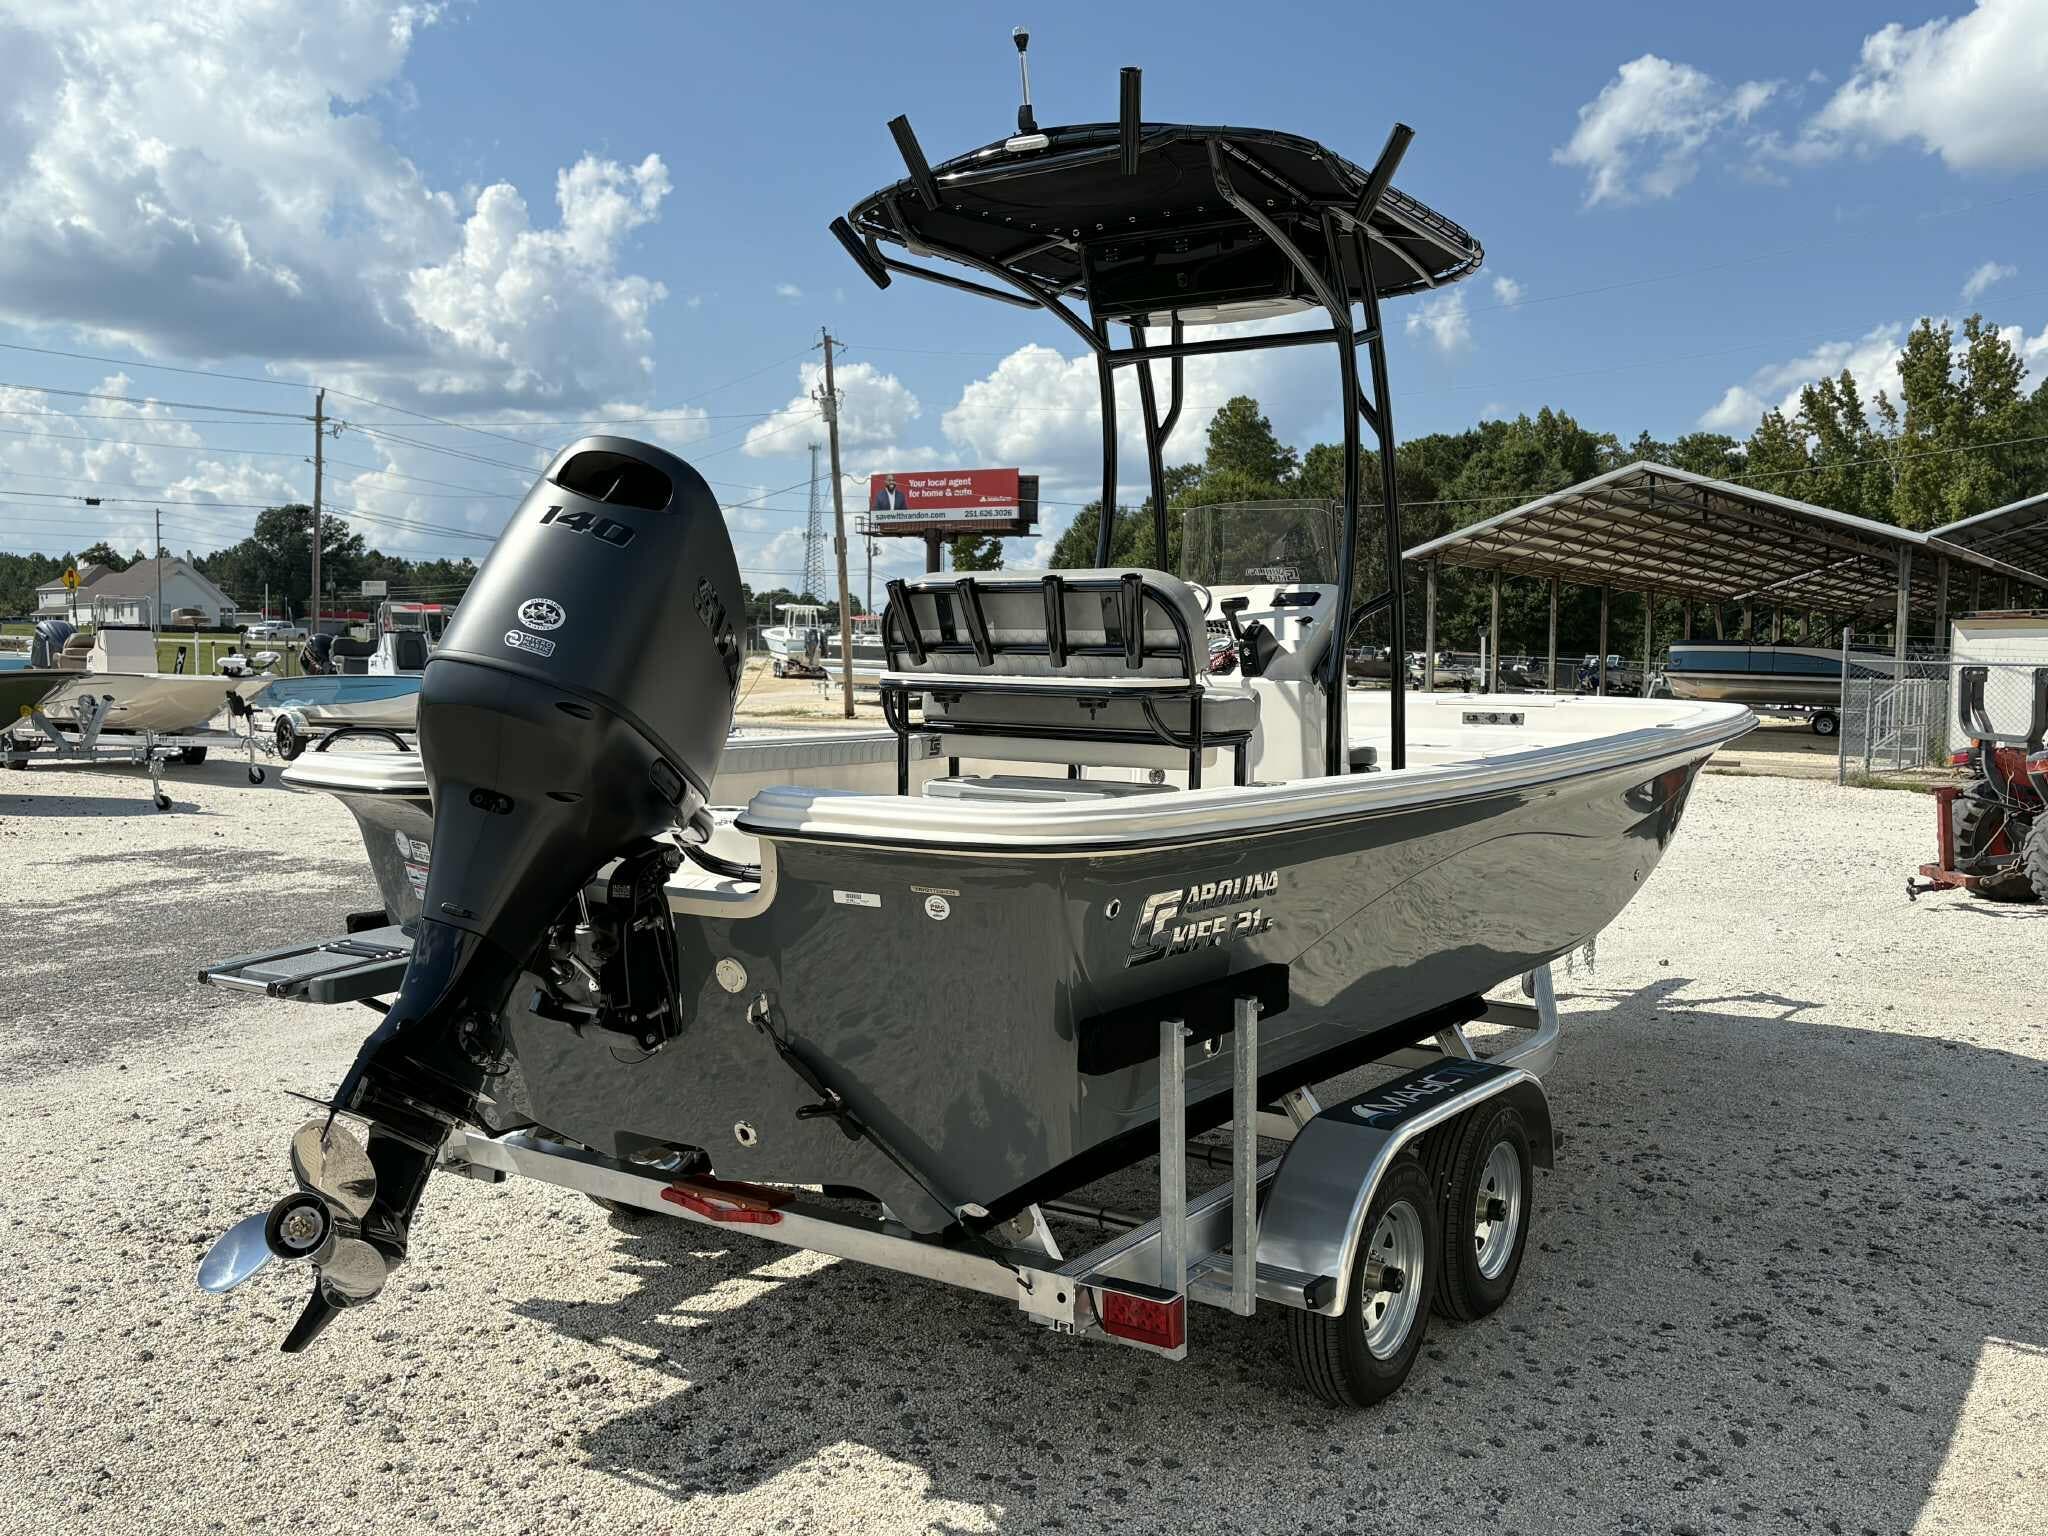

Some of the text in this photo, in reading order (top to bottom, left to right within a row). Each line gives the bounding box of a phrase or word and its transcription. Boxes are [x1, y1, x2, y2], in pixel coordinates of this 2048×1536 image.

[909, 477, 971, 488] Your local agent
[909, 488, 972, 498] for home & auto
[540, 505, 637, 549] 140
